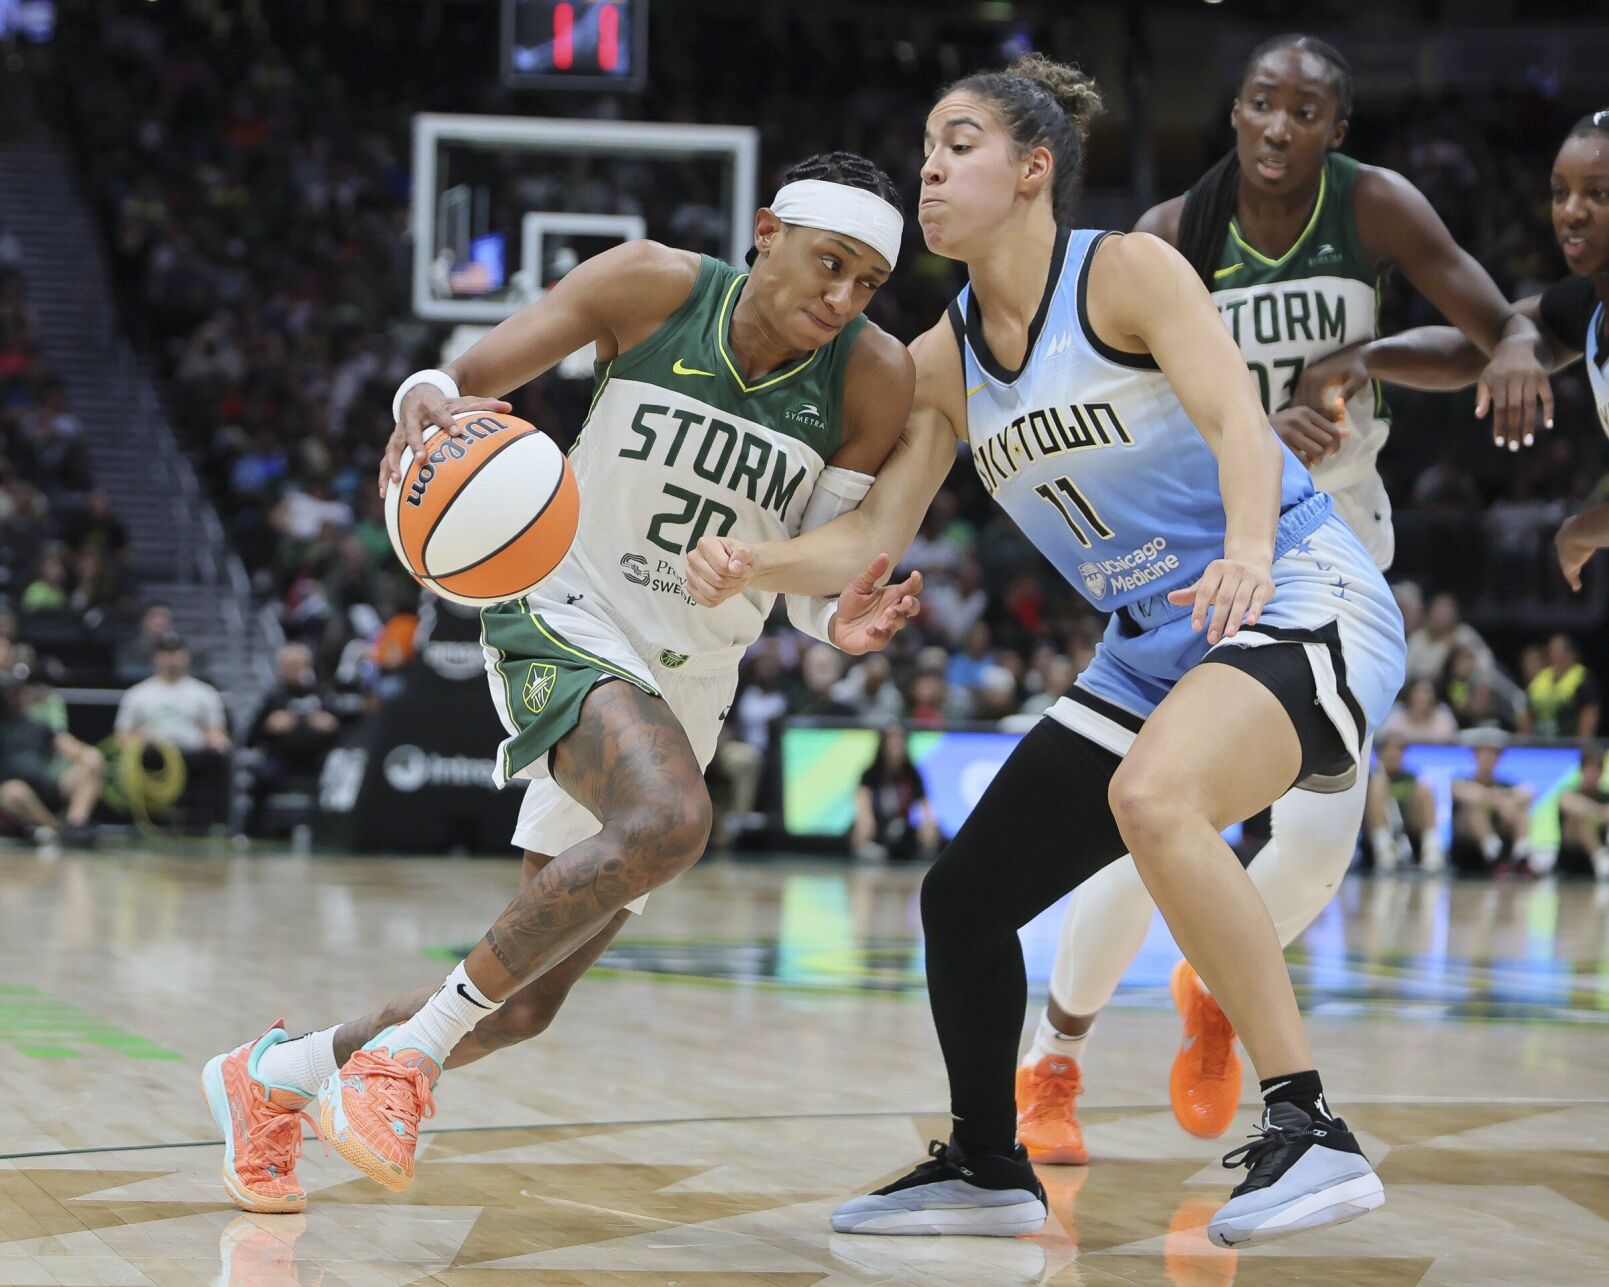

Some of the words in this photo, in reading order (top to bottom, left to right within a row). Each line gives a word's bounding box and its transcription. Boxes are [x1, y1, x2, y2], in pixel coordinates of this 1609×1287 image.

[552, 1, 620, 72] 11
[1217, 289, 1347, 350] TORM
[784, 410, 826, 430] SYMETRA
[406, 415, 510, 507] Wilson
[618, 403, 807, 523] STORM
[646, 482, 738, 557] 20
[1032, 475, 1116, 549] 11
[1096, 536, 1167, 575] UChicago
[1110, 554, 1180, 596] Medicine
